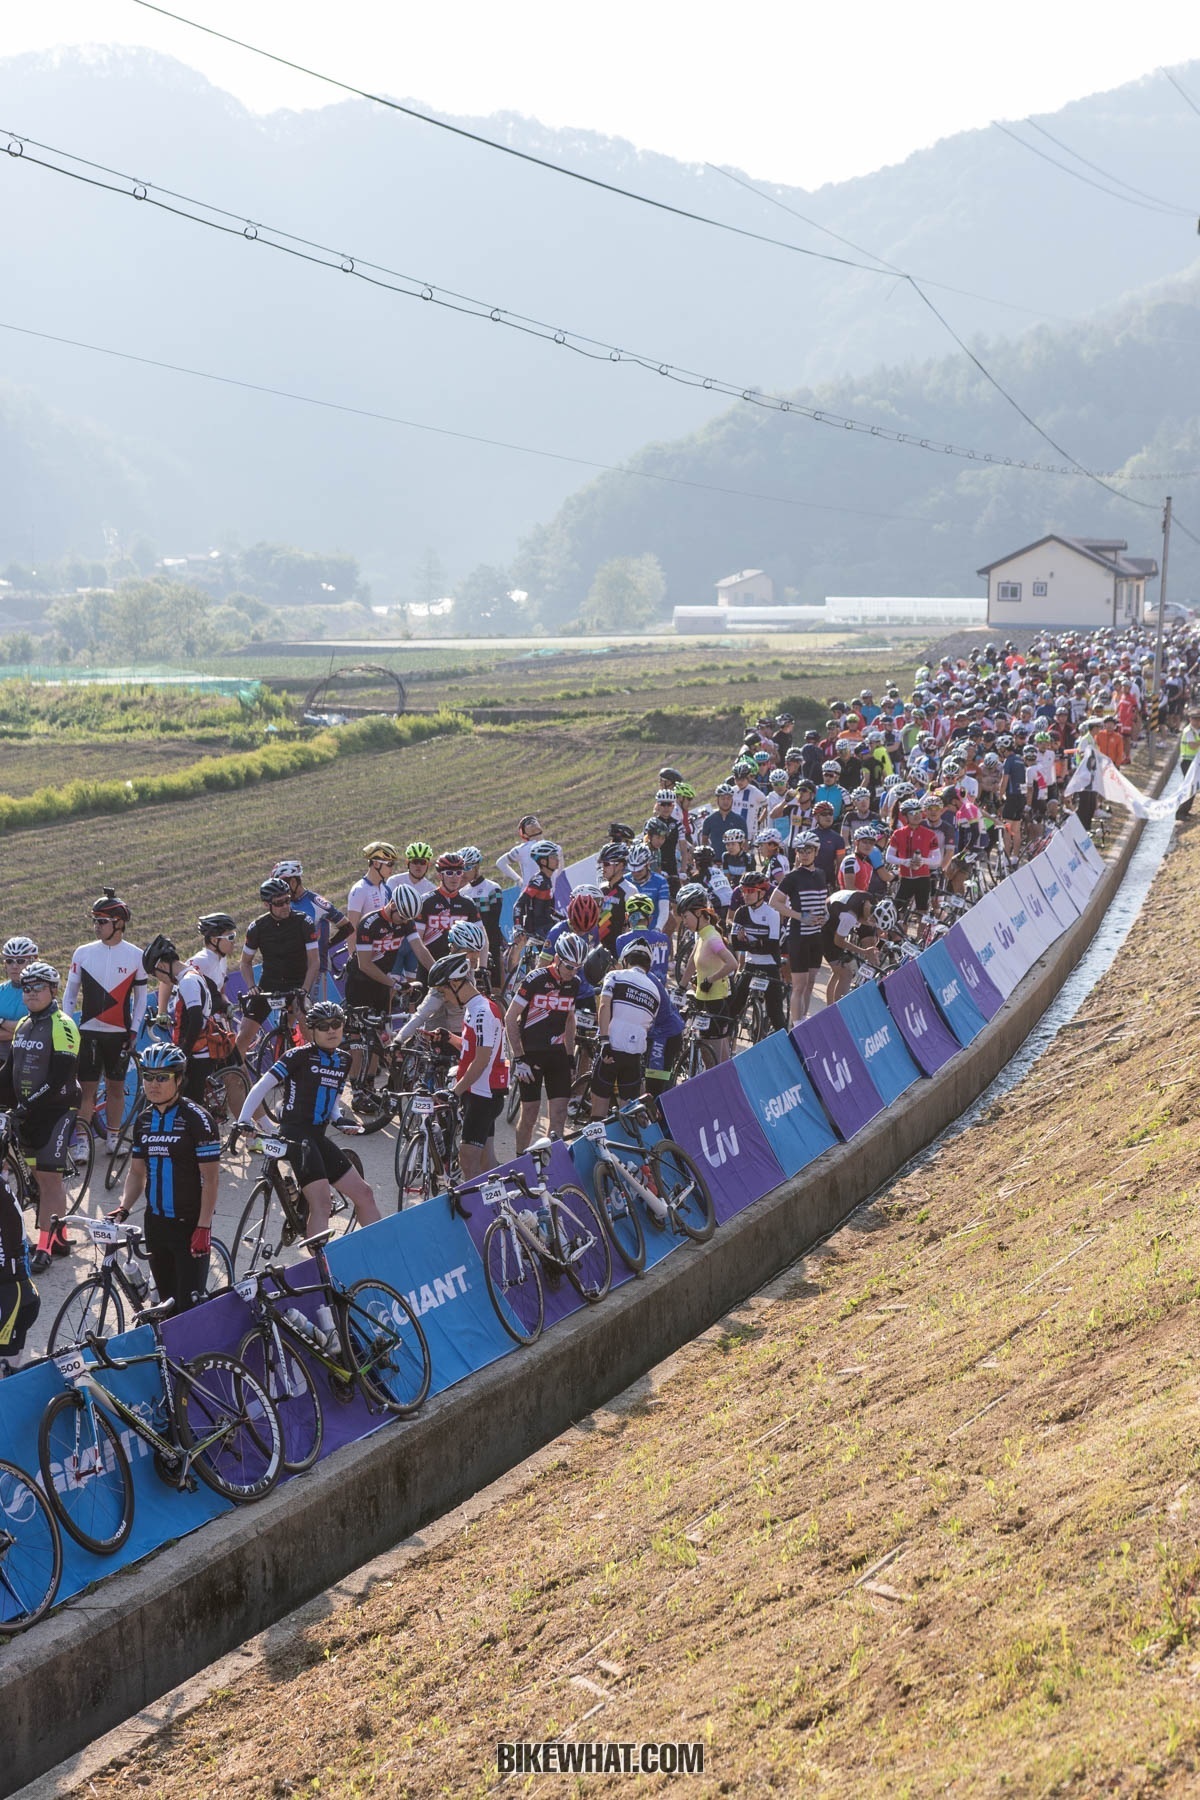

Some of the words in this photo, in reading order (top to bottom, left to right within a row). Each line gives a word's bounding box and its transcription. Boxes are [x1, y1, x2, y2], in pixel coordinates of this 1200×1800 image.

[993, 921, 1015, 950] Liv
[960, 957, 980, 989] Liv
[904, 1002, 928, 1038] Liv
[13, 1037, 44, 1050] allegro
[865, 1025, 891, 1057] GIANT
[320, 1068, 345, 1078] GIANT
[822, 1051, 852, 1093] Liv
[288, 1080, 297, 1104] GIANT
[767, 1083, 803, 1119] GIANT
[192, 1107, 212, 1133] GIANT
[147, 1135, 182, 1143] GIANT
[265, 1144, 281, 1154] 1051
[699, 1118, 740, 1168] Liv
[484, 1190, 502, 1200] 2241
[93, 1230, 112, 1240] 1584
[391, 1265, 469, 1326] GIANT
[280, 1316, 329, 1357] SCOTT
